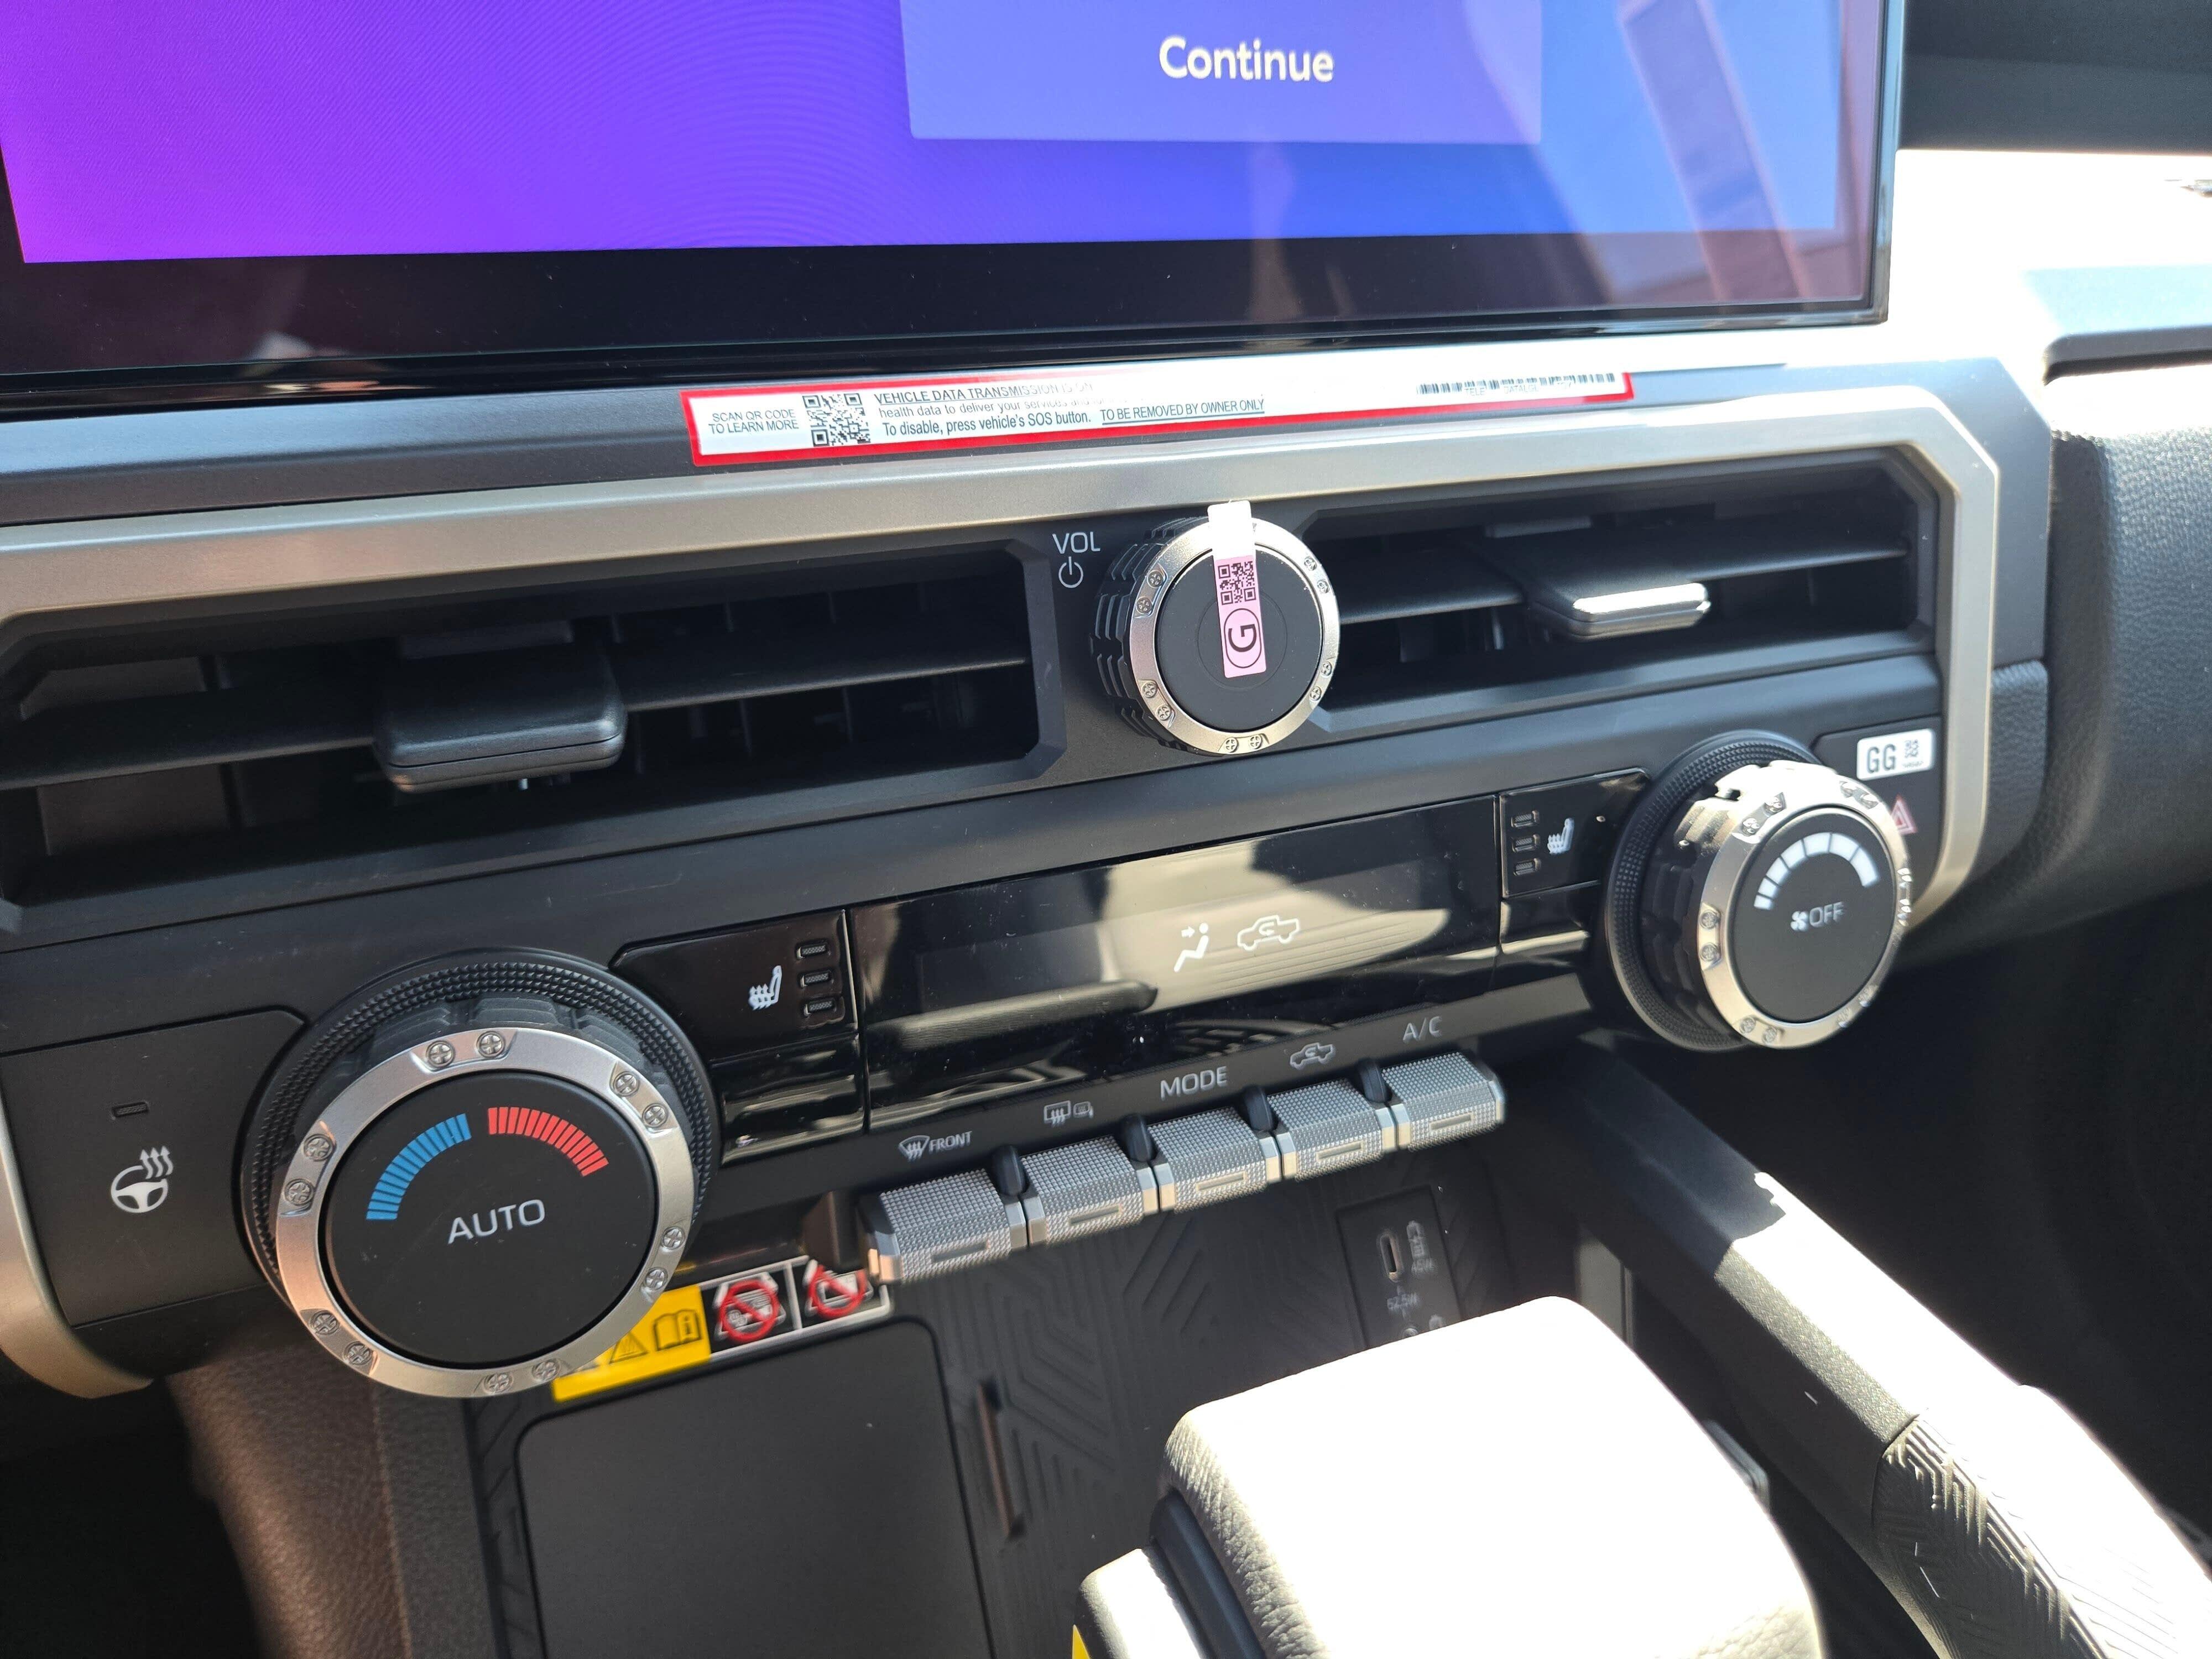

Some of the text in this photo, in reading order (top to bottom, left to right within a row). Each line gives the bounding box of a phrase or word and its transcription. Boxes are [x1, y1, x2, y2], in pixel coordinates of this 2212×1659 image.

[1159, 35, 1334, 82] Continue
[874, 391, 930, 404] VEHICLE
[932, 389, 967, 401] DATA
[968, 384, 1058, 399] TRANSMISSION
[712, 409, 796, 422] SCAN QR CODE
[879, 407, 914, 418] health
[917, 405, 942, 416] data
[945, 404, 956, 414] to
[959, 402, 994, 413] deliver
[997, 401, 1021, 414] your
[1024, 399, 1067, 410] services
[1100, 399, 1264, 421] TO BE REMOVED BY OWNER ONLY
[708, 419, 799, 434] TO LEARN MORE
[882, 411, 1091, 436] To disable, press vehicle's SOS button.
[1052, 531, 1100, 554] VOL
[1228, 623, 1257, 653] G
[1867, 744, 1896, 774] GG
[1809, 901, 1844, 927] OFF
[1403, 1016, 1442, 1044] A/C
[1161, 1066, 1227, 1100] MODE
[929, 1131, 973, 1154] FRONT
[448, 1199, 545, 1244] AUTO
